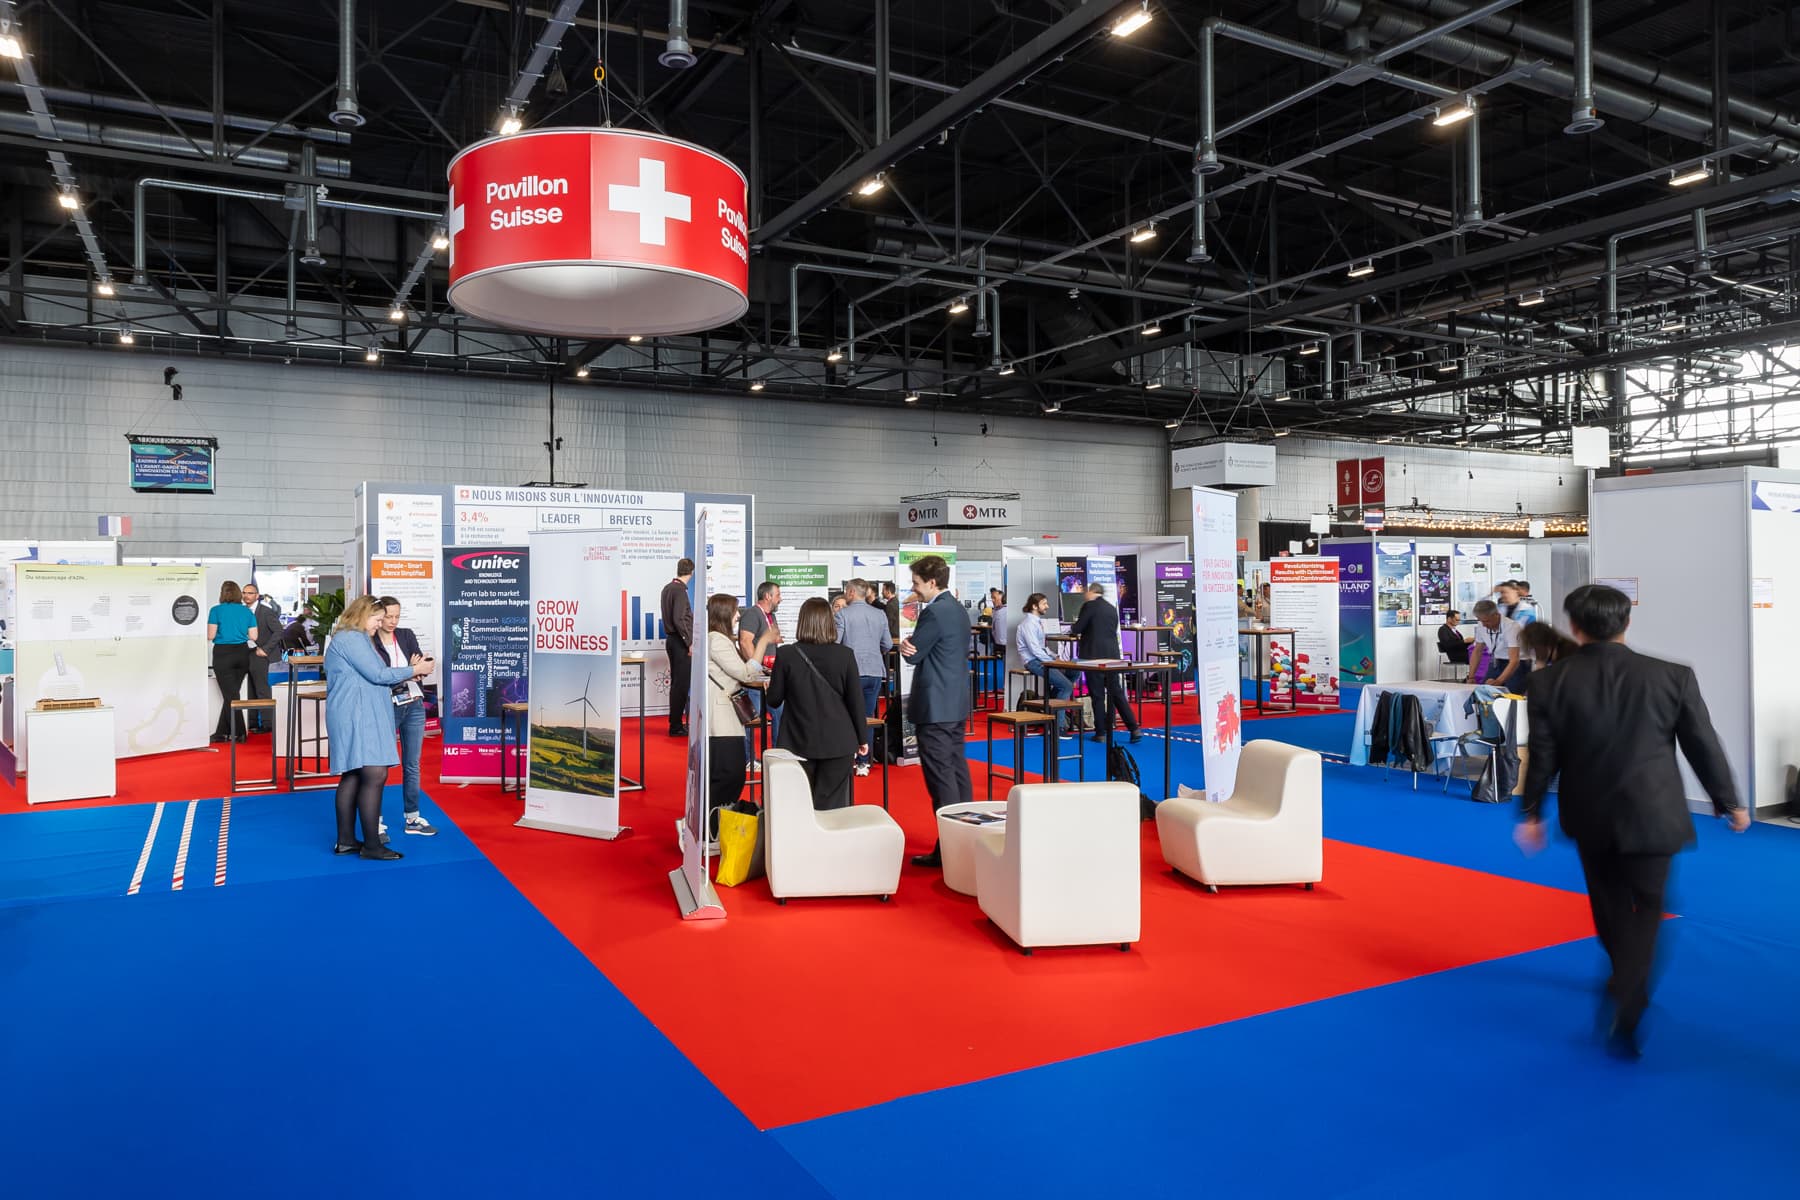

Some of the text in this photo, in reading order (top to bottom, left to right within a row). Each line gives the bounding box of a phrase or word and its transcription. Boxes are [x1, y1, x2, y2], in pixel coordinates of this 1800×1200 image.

[486, 176, 568, 203] Pavillon
[490, 206, 562, 230] Suisse
[472, 490, 643, 504] NOUS MISONS SUR L'INNOVATION
[542, 513, 580, 524] LEADER
[610, 514, 652, 525] BREVETS
[919, 508, 938, 520] MTR
[980, 508, 1006, 518] MTR
[471, 555, 520, 569] unitec
[537, 600, 578, 615] GROW
[537, 617, 574, 632] YOUR
[537, 634, 608, 651] BUSINESS
[451, 663, 485, 672] Industry
[478, 674, 486, 718] Networking
[444, 747, 459, 756] HUG
